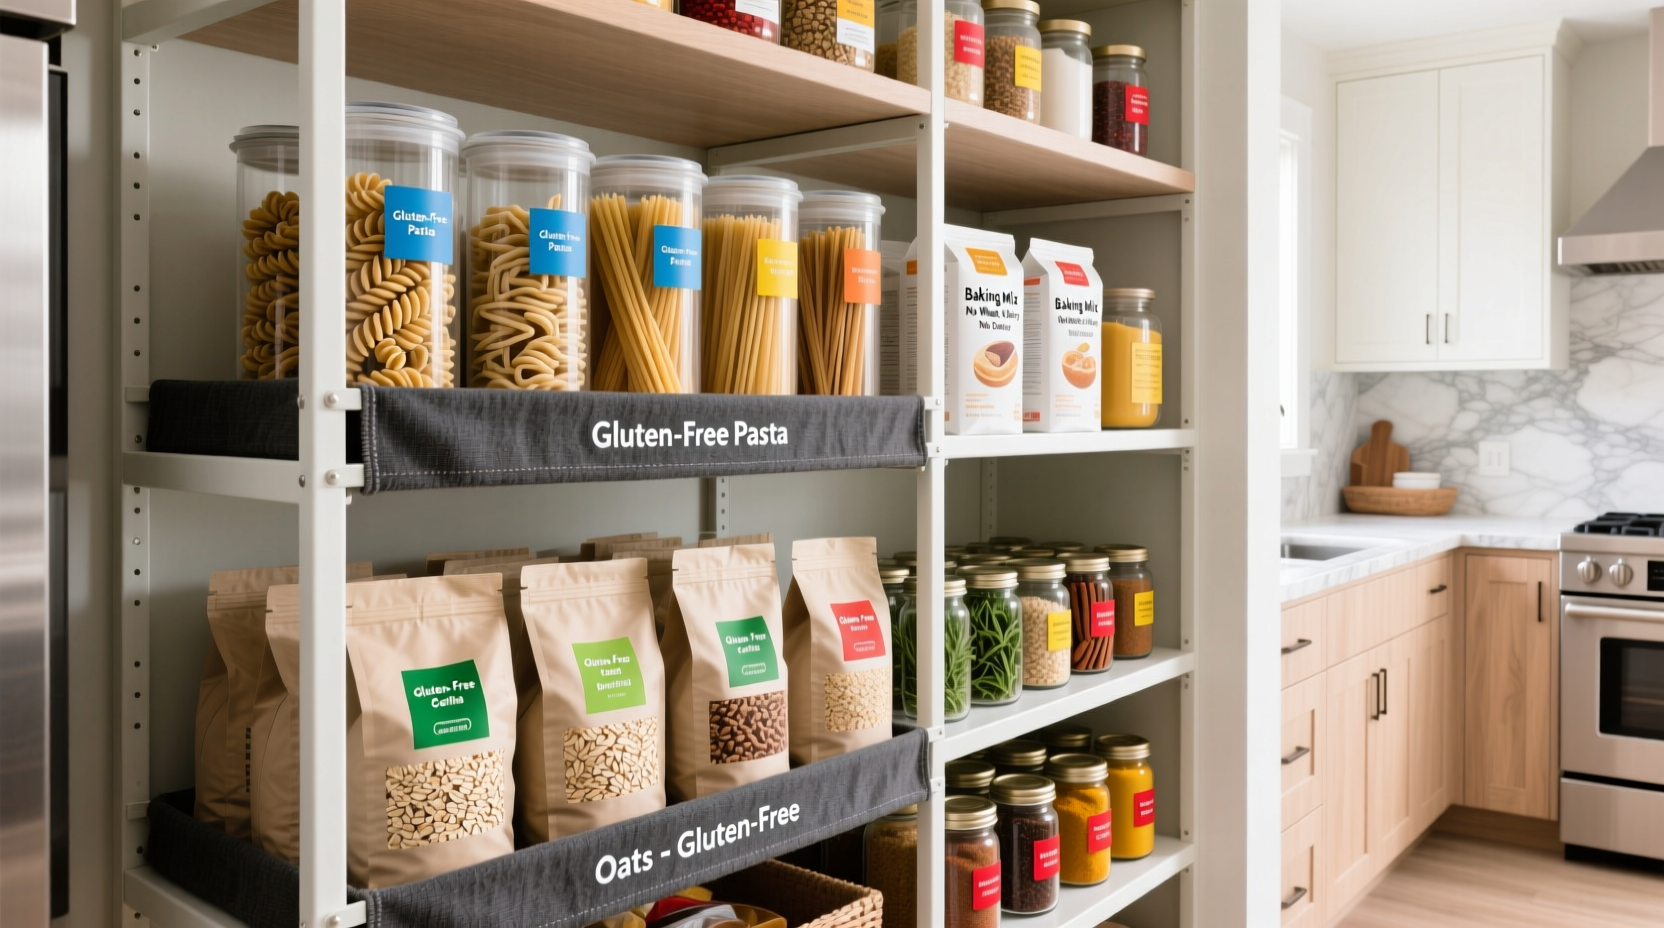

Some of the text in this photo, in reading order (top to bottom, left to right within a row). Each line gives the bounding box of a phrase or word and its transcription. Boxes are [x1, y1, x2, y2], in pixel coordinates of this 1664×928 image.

[965, 286, 1001, 307] Baking
[591, 420, 789, 449] Gluten-Free Pasta
[595, 848, 654, 884] Oats
[677, 803, 800, 858] Gluten-Free
